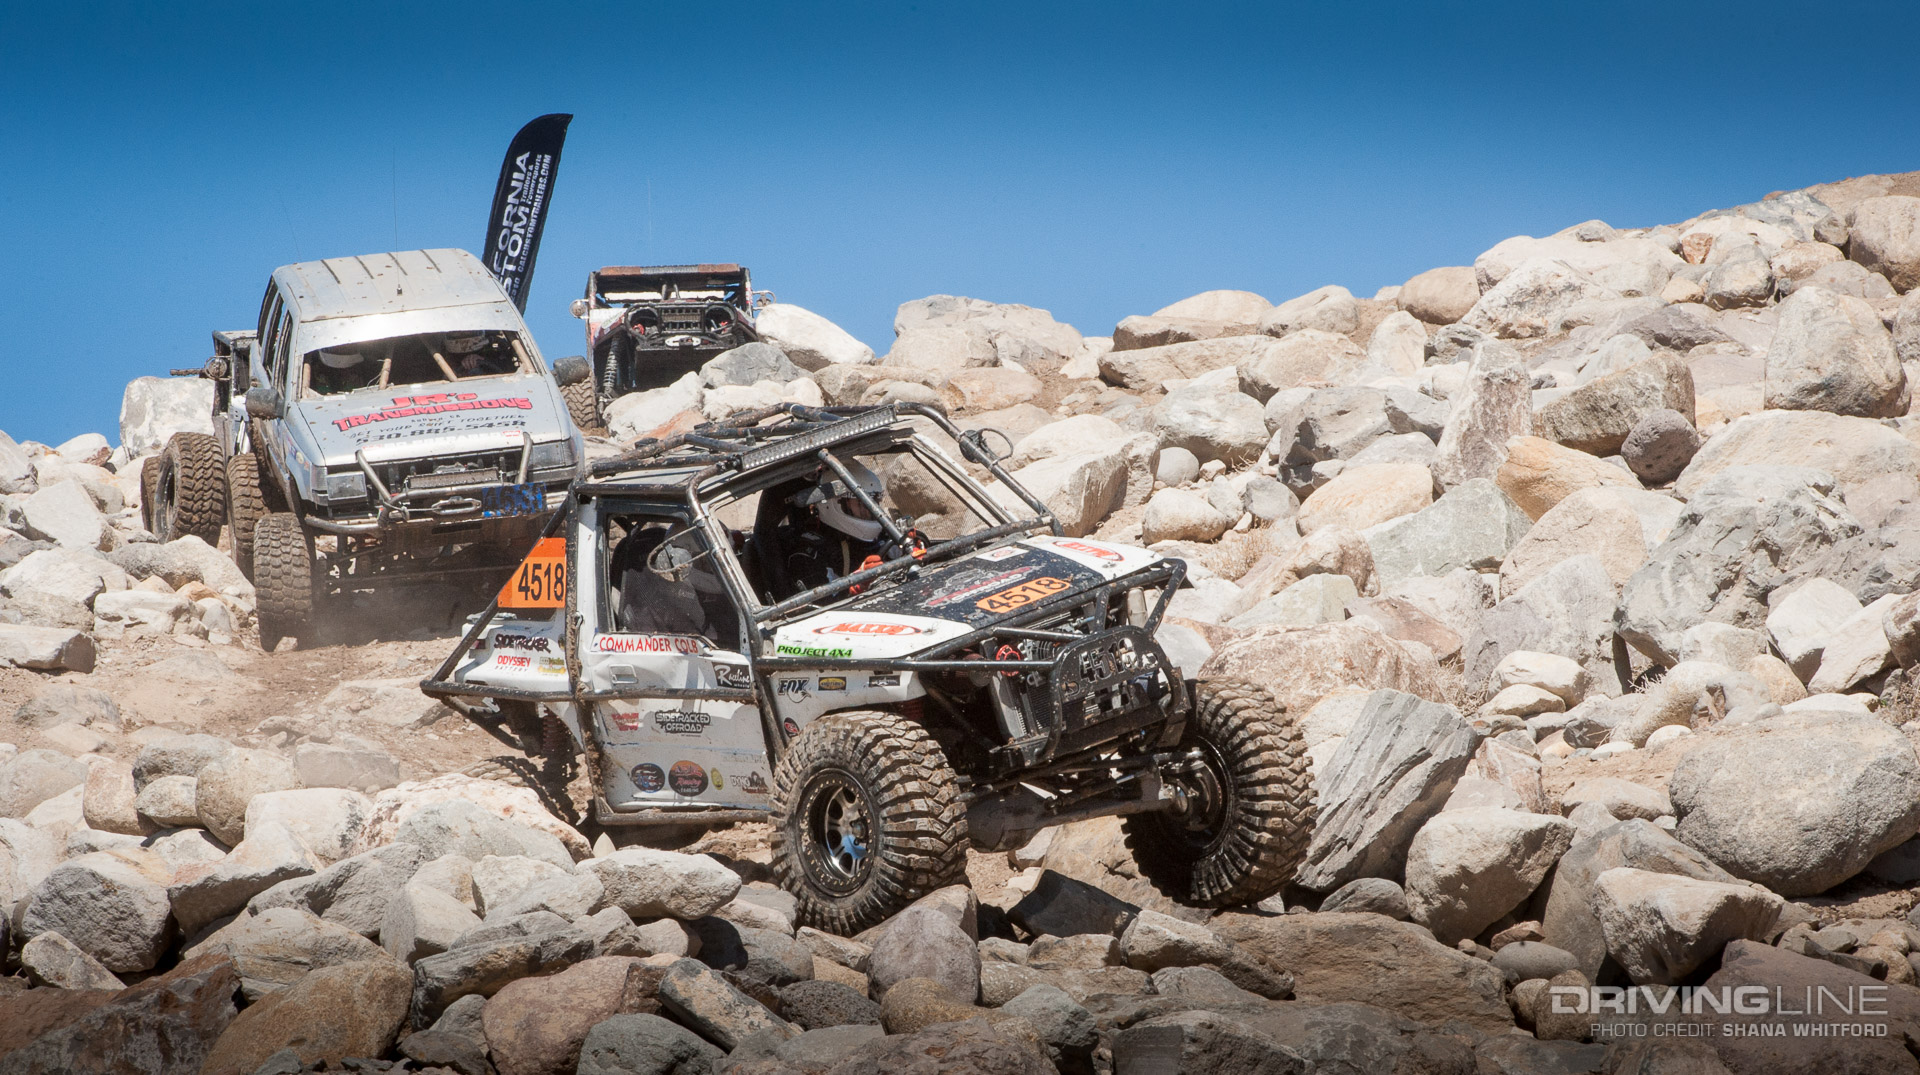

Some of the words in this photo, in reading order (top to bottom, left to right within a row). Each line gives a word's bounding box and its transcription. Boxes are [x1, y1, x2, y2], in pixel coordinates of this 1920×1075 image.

[332, 397, 533, 432] TRANSMISSIONS
[518, 562, 566, 602] 4518
[988, 578, 1067, 610] 4518
[599, 636, 672, 653] COMMANDER
[777, 645, 829, 657] PROJECT
[829, 648, 853, 658] 4X4
[497, 655, 532, 668] ODYSSEY
[778, 677, 810, 696] FOX
[655, 712, 710, 725] SIDETRACKED
[665, 723, 703, 733] OFFROAD
